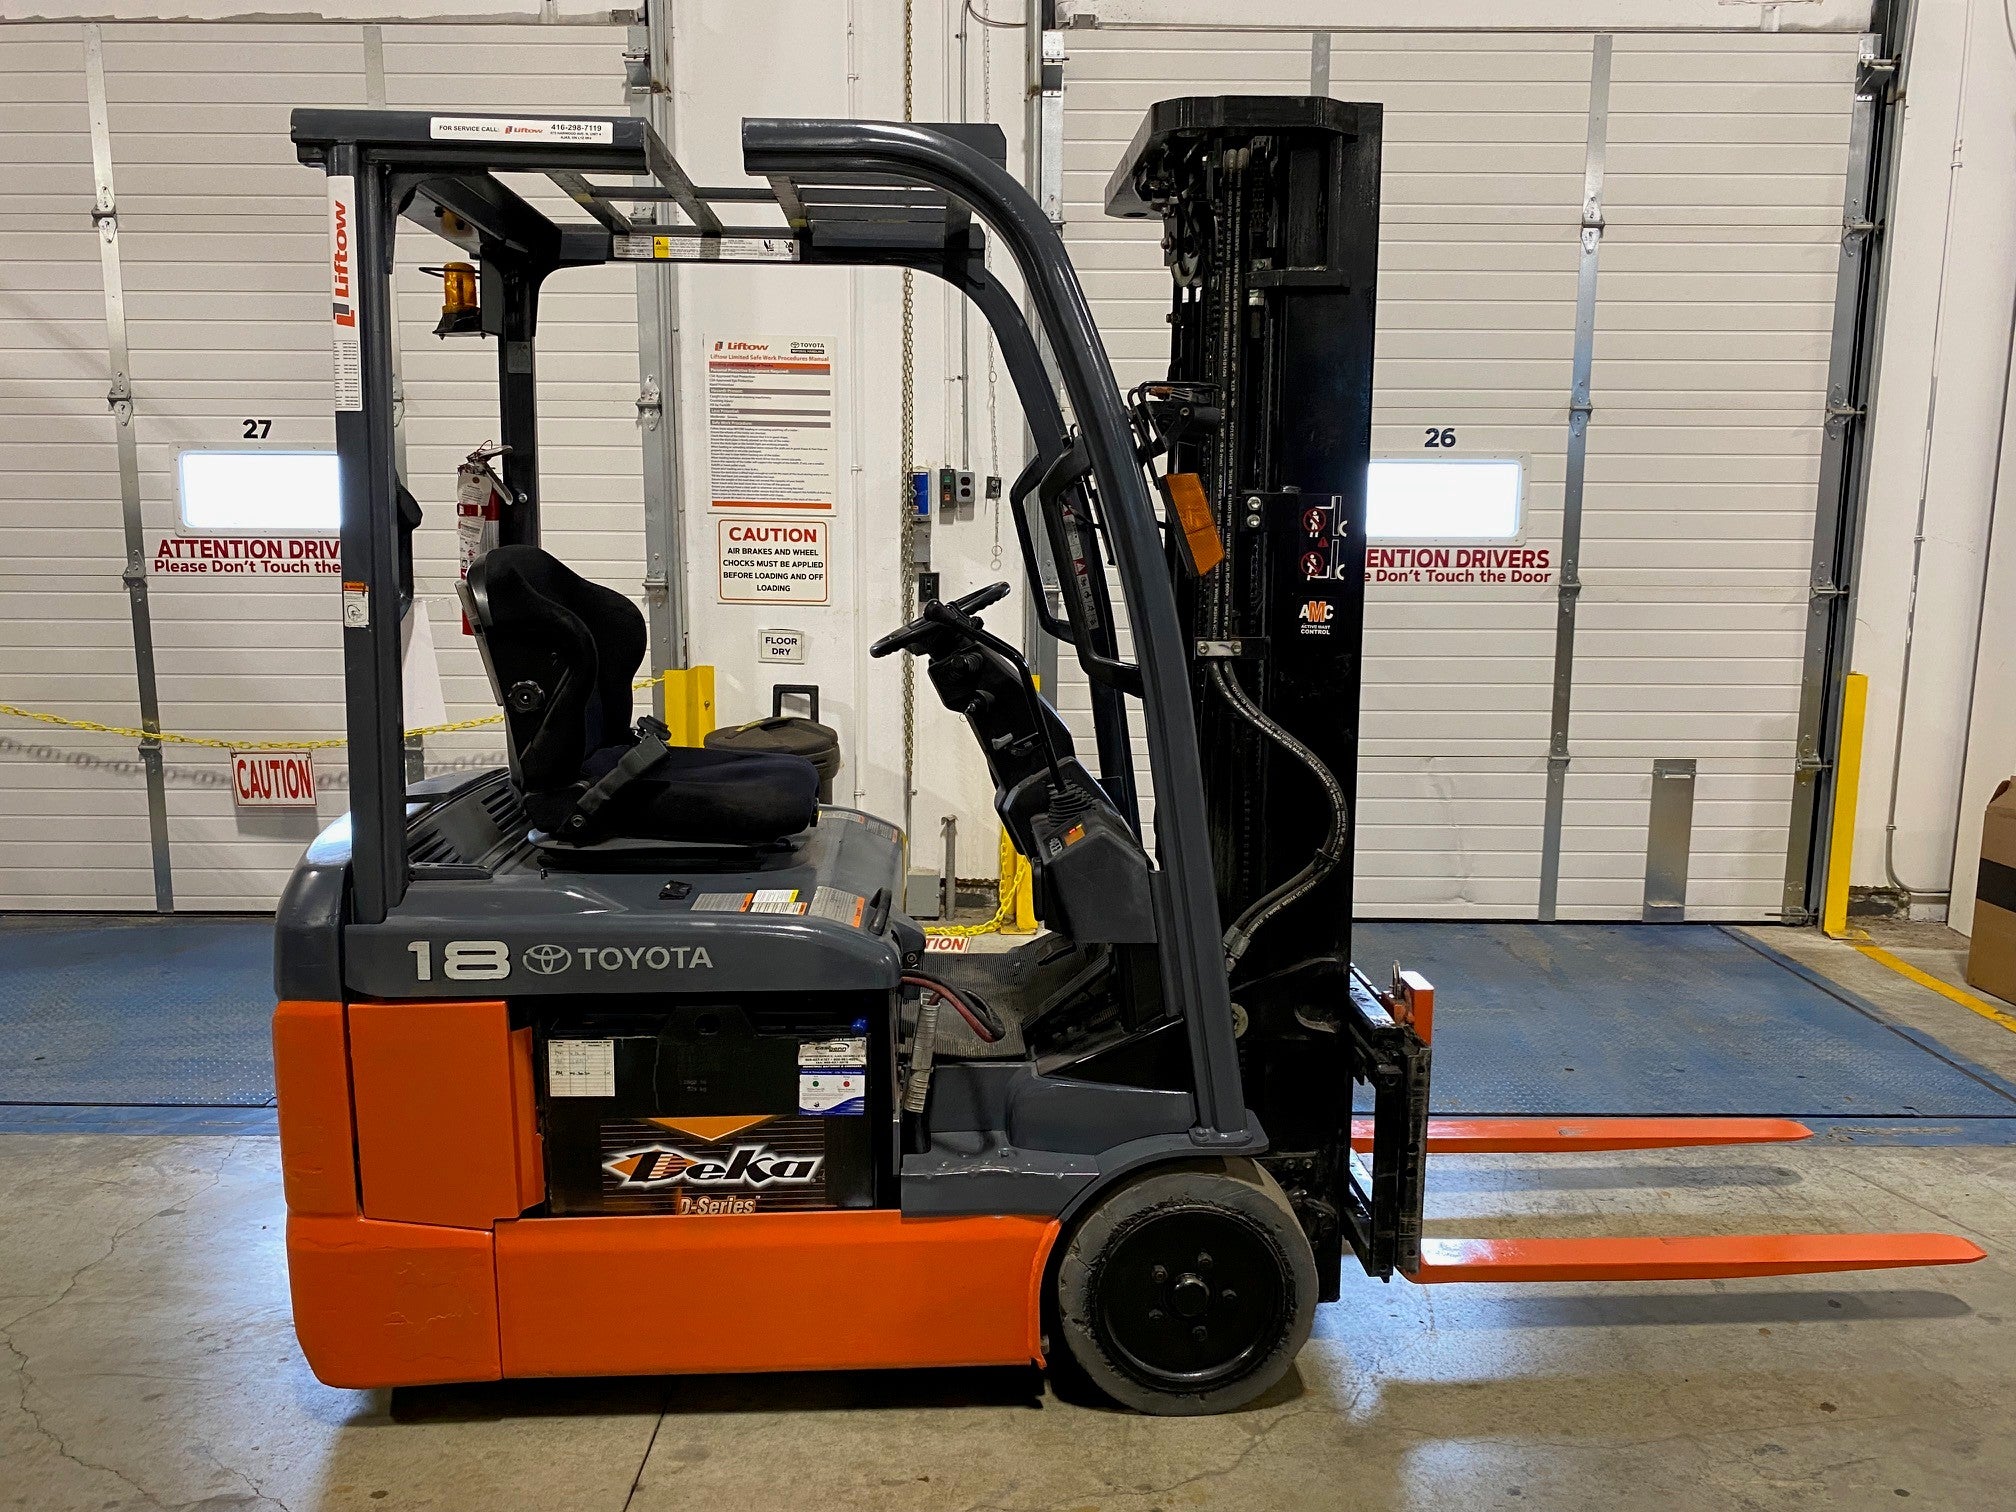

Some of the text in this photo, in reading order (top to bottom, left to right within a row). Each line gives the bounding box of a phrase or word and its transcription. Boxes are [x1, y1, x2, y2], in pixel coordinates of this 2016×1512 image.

[334, 201, 349, 298] Liftow
[728, 342, 769, 350] Liftow
[243, 419, 272, 439] 27
[1424, 428, 1456, 448] 26
[729, 527, 817, 542] CAUTION
[158, 540, 340, 559] ATTENTION DRIV
[1366, 549, 1550, 568] ENTION DRIVERS
[154, 560, 341, 573] Please Don't Touch the
[1376, 569, 1420, 582] Don't
[1426, 570, 1475, 582] Touch
[1480, 570, 1506, 582] the
[1511, 570, 1551, 583] Door
[1299, 601, 1334, 622] AMC
[765, 637, 797, 645] FLOOR
[237, 759, 312, 799] CAUTION
[926, 938, 965, 950] TION
[407, 940, 713, 980] 18 TOYOTA
[608, 1146, 821, 1186] Deka
[680, 1196, 756, 1214] D-Series
